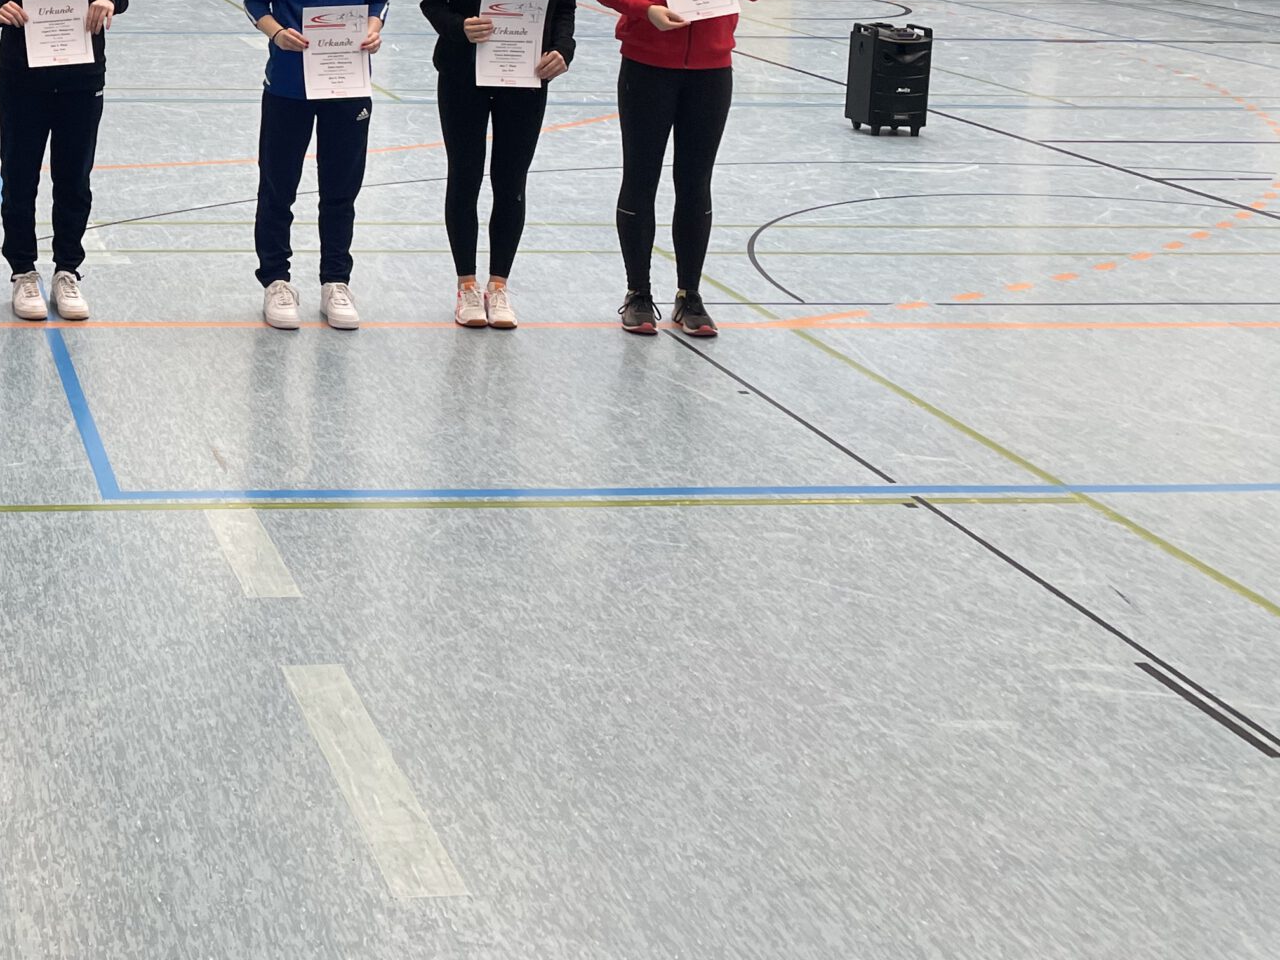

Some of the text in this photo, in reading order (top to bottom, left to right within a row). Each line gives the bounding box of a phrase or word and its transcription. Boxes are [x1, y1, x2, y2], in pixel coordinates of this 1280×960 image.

[38, 5, 75, 16] Urkunde
[492, 26, 528, 36] Urkunde
[317, 39, 354, 48] Urkunde
